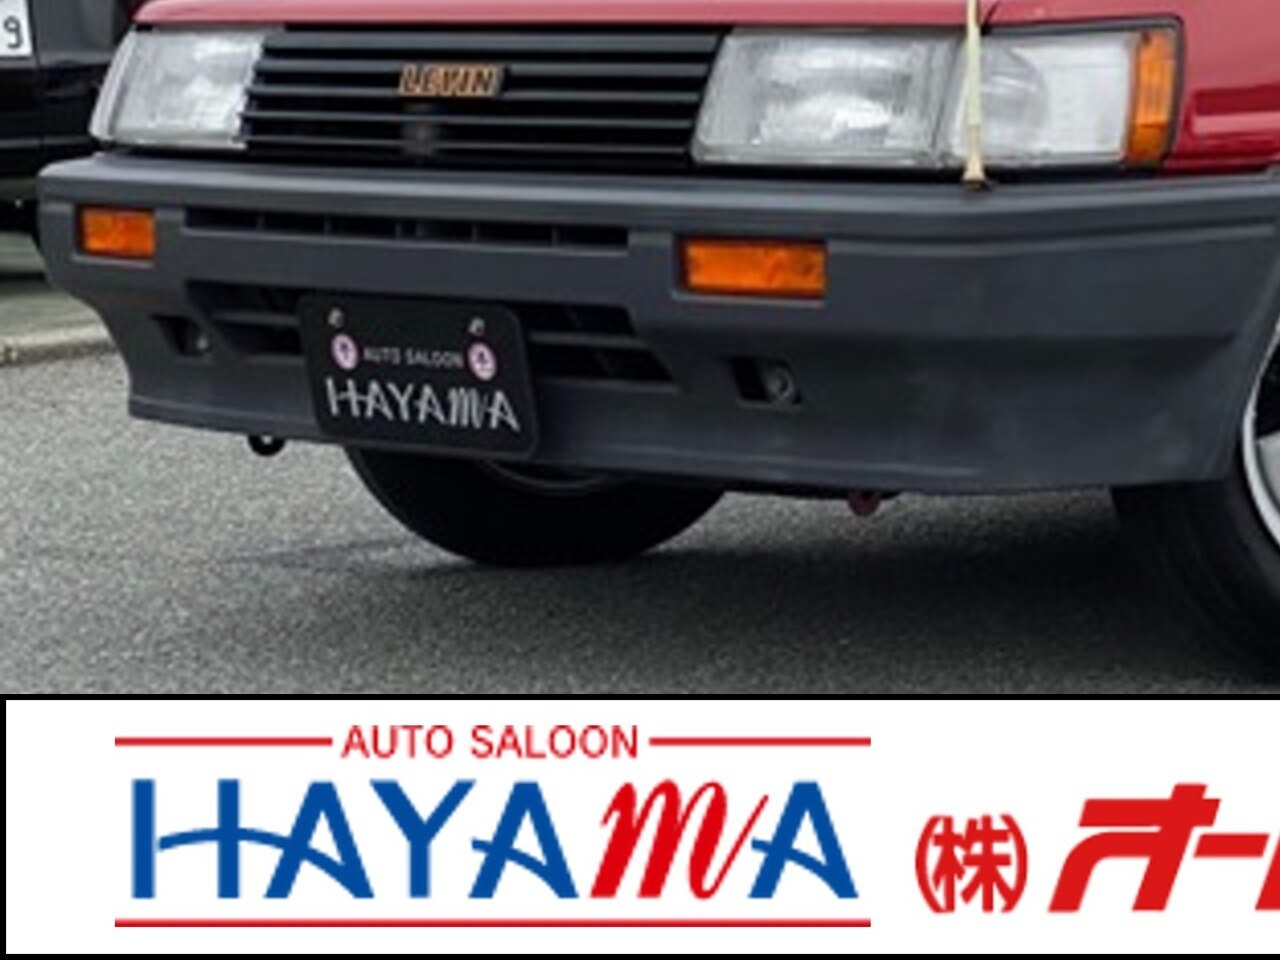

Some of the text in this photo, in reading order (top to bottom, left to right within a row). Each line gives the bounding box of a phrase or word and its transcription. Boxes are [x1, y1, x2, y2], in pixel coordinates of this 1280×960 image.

[398, 63, 498, 97] LEVIN
[363, 346, 464, 370] AUTO SALOON
[325, 376, 520, 433] HAYAMA
